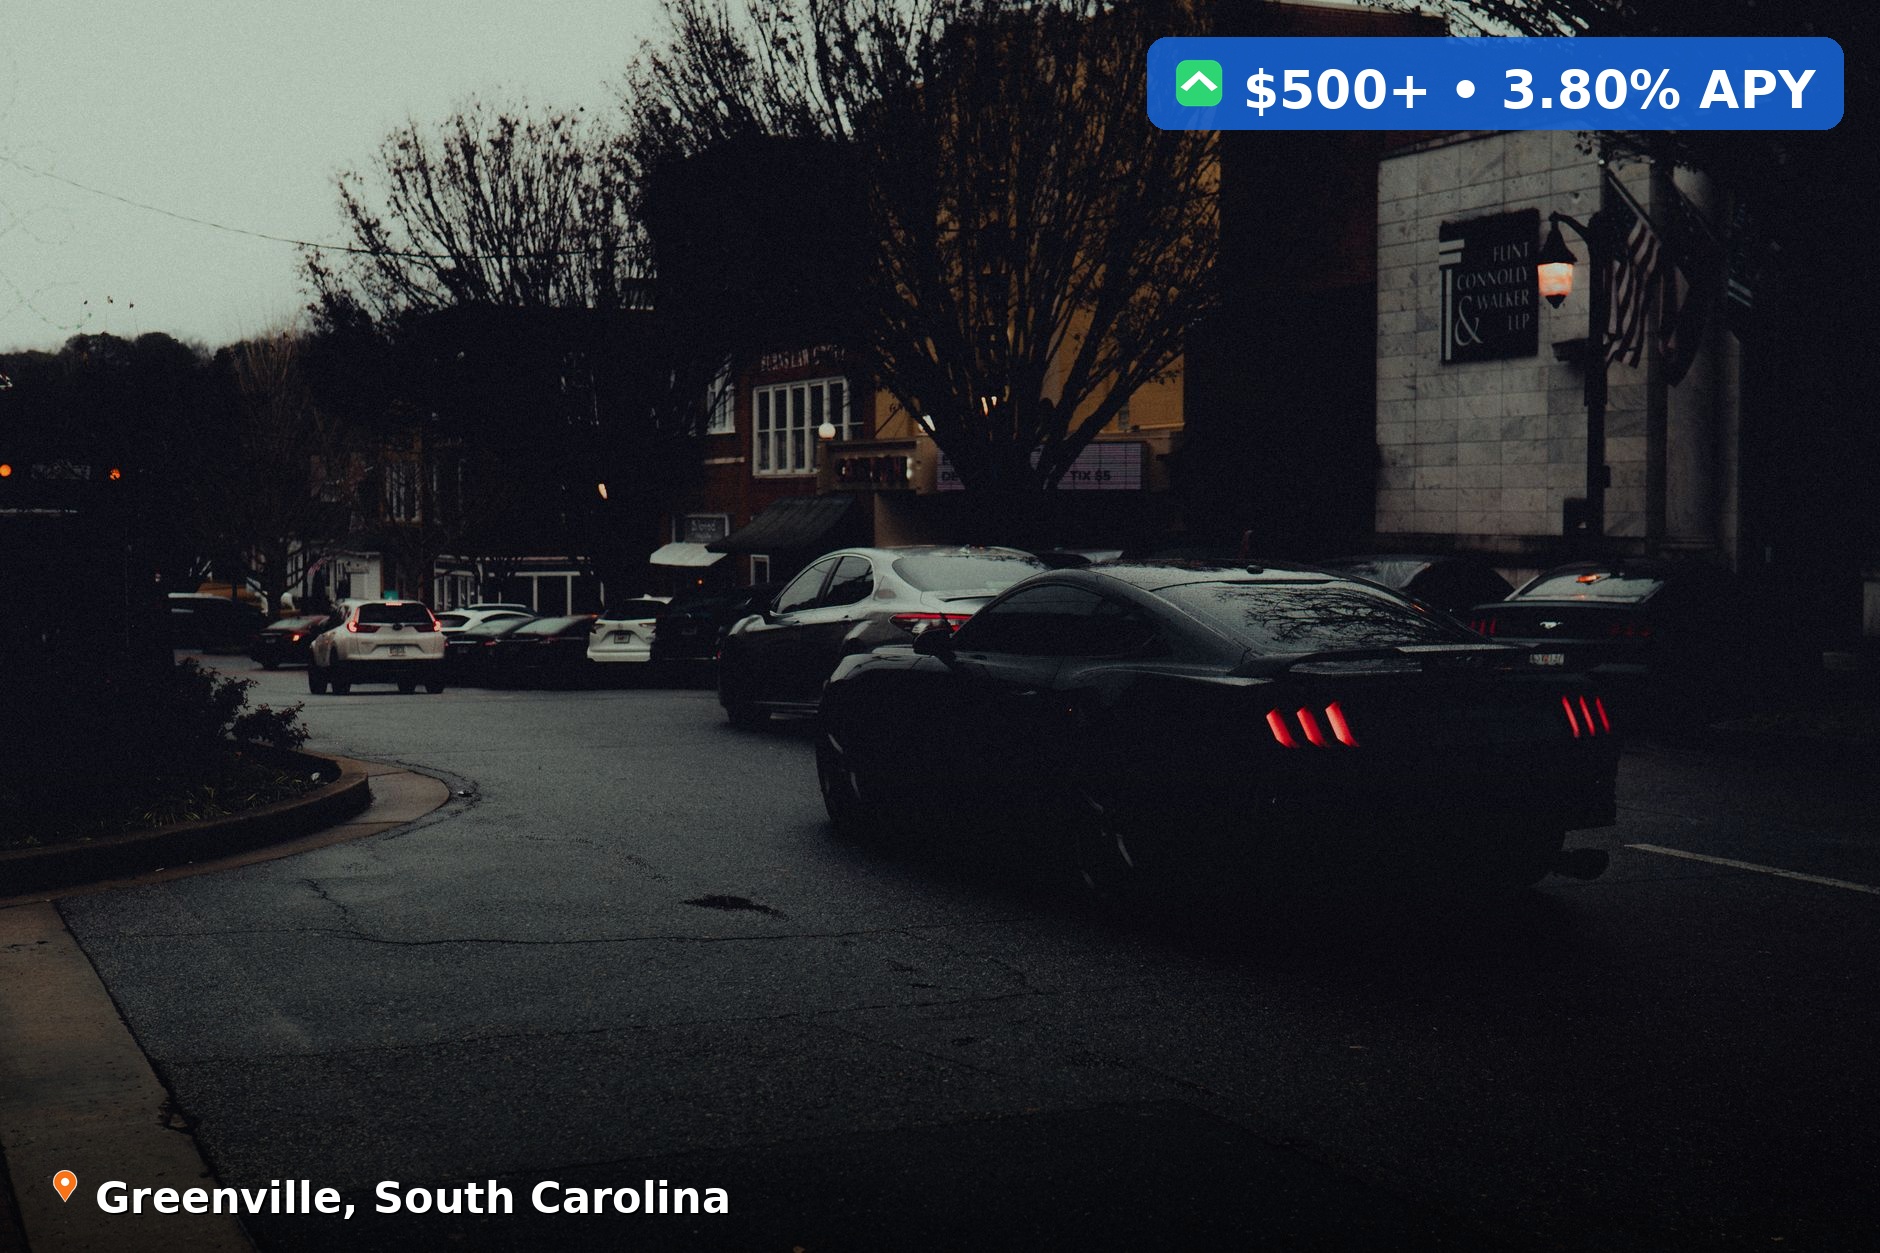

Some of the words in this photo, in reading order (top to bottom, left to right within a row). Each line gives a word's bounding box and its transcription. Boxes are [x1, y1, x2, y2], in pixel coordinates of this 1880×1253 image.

[1493, 241, 1530, 262] FLINT
[1456, 265, 1528, 291] CONNOLLY
[1476, 288, 1530, 310] WALKER
[1508, 312, 1530, 332] LLP
[1070, 470, 1091, 481] TIX
